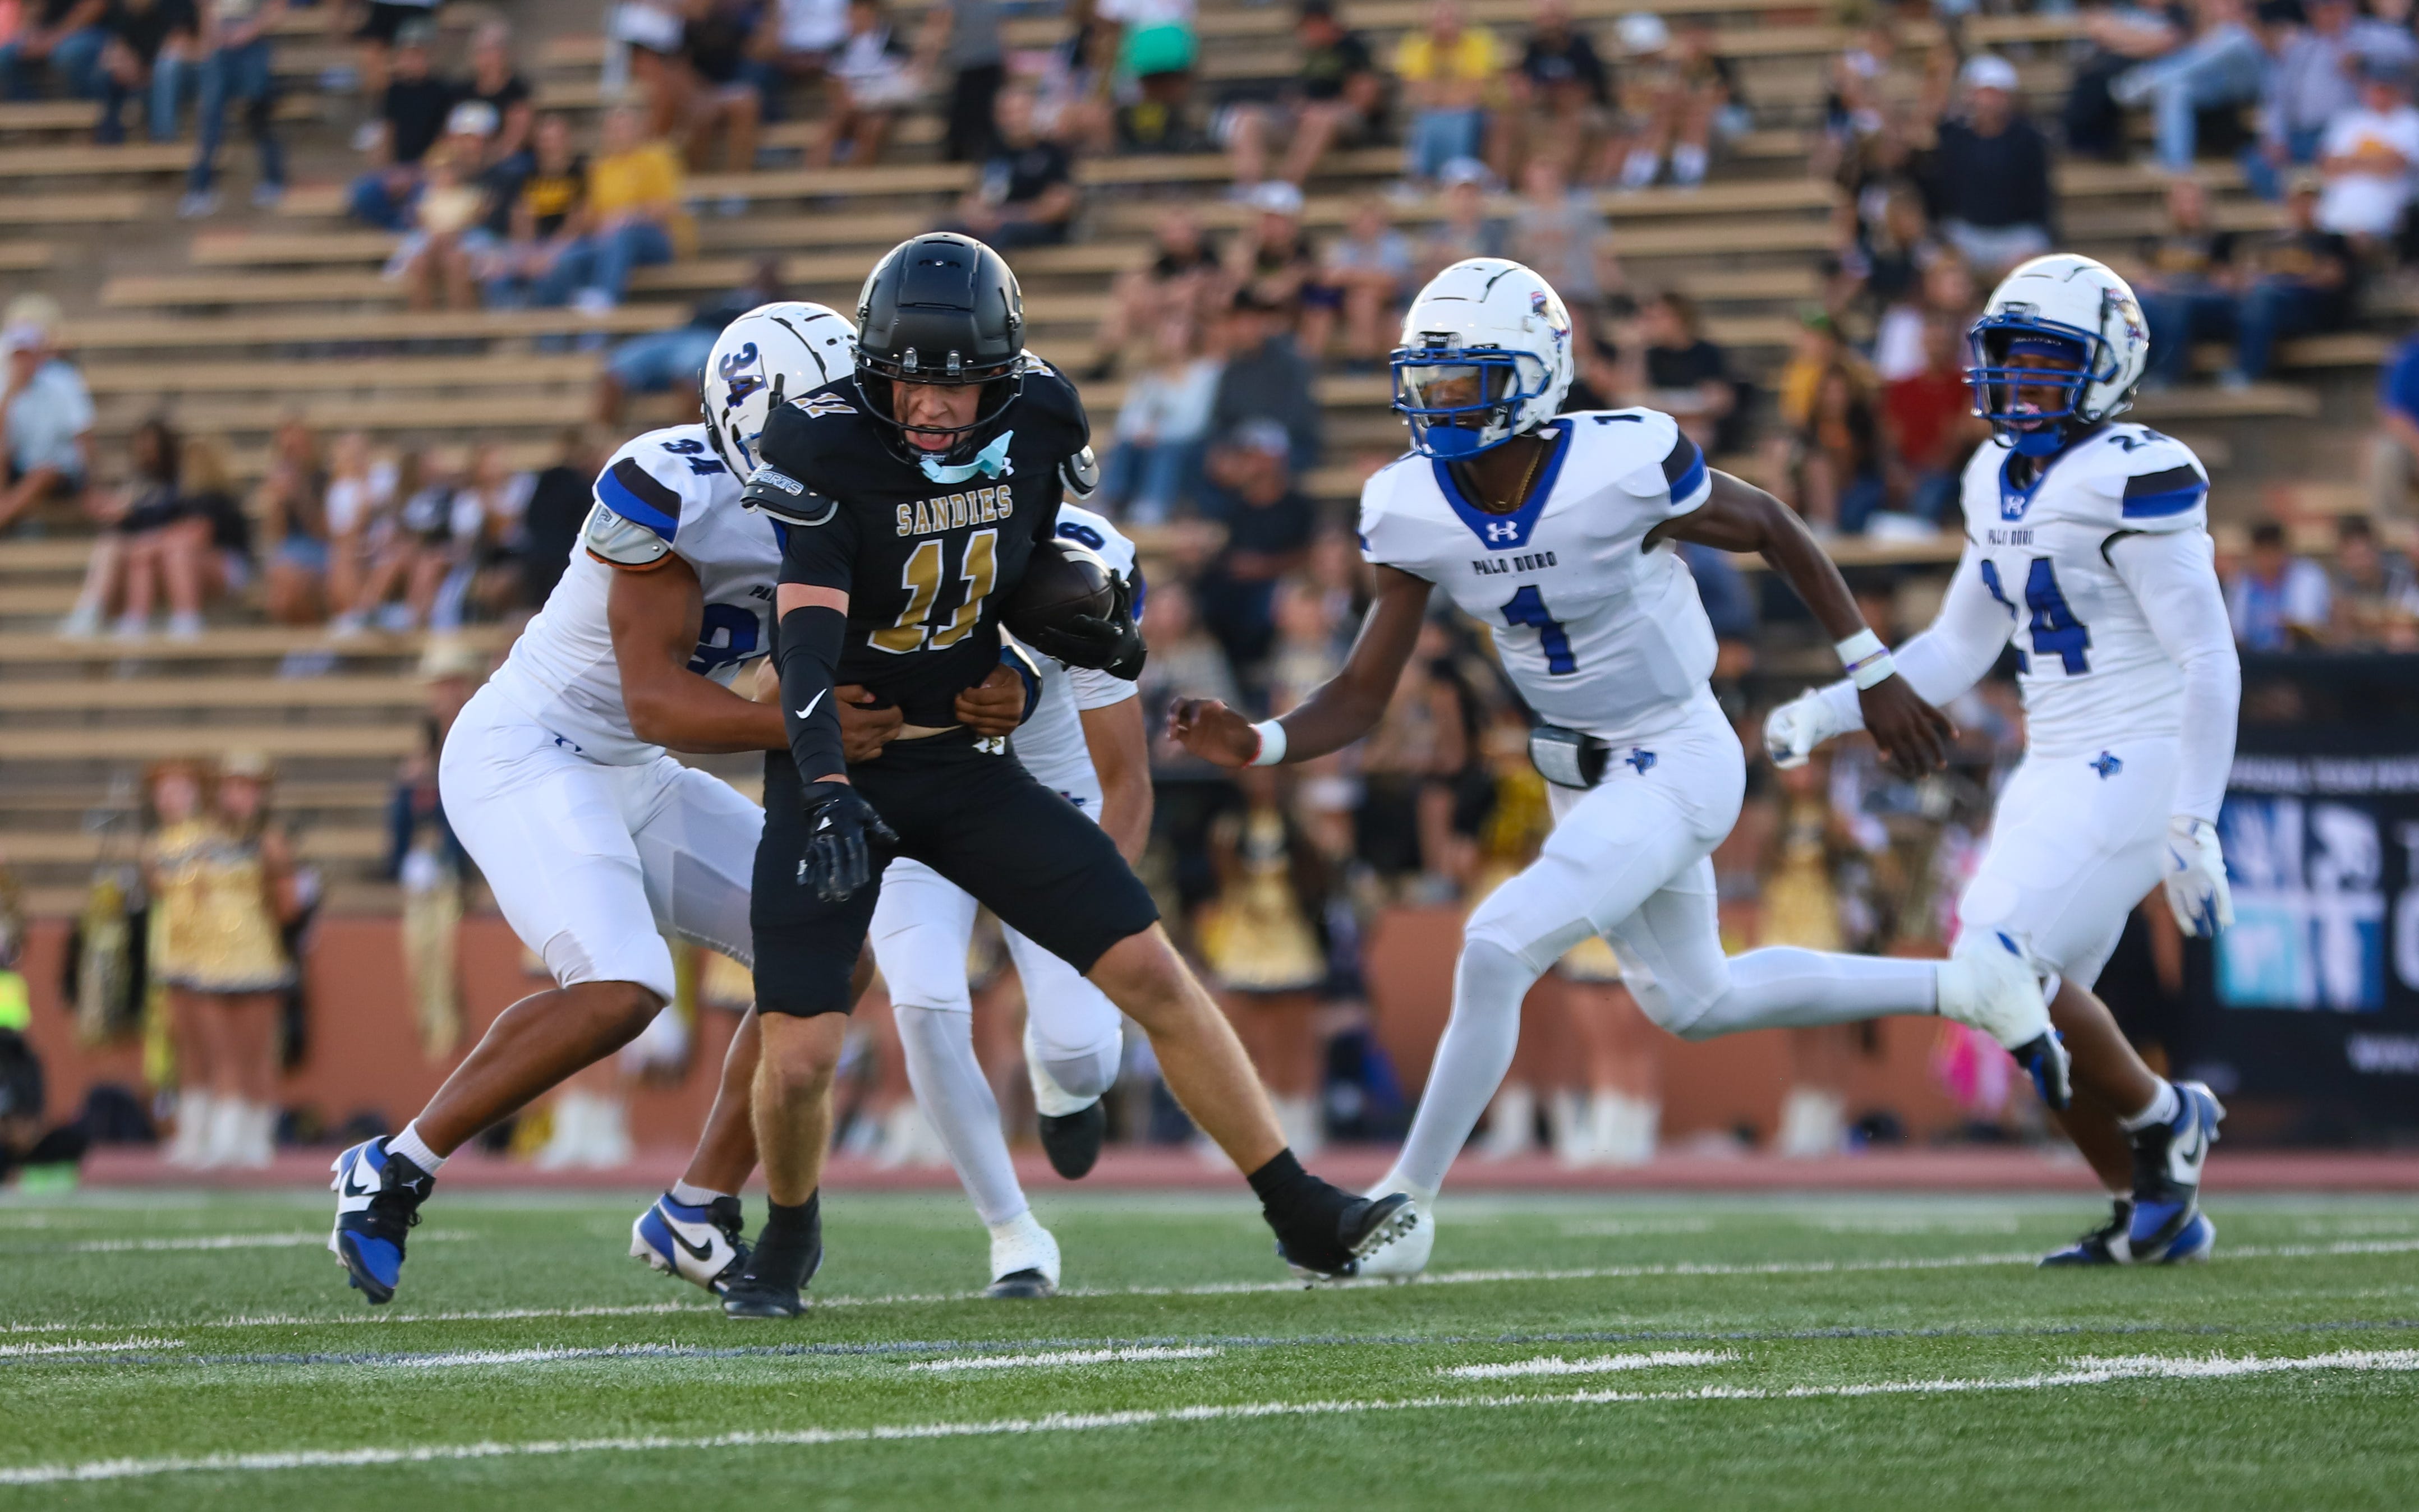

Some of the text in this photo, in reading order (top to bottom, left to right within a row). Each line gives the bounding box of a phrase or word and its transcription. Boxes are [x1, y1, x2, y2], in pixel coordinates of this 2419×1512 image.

[719, 342, 766, 408] 34
[659, 439, 728, 476] 34
[896, 484, 1013, 537] SANDIES
[866, 528, 999, 654] 11
[1472, 551, 1558, 575] PALO DURO
[1501, 584, 1579, 676] 1
